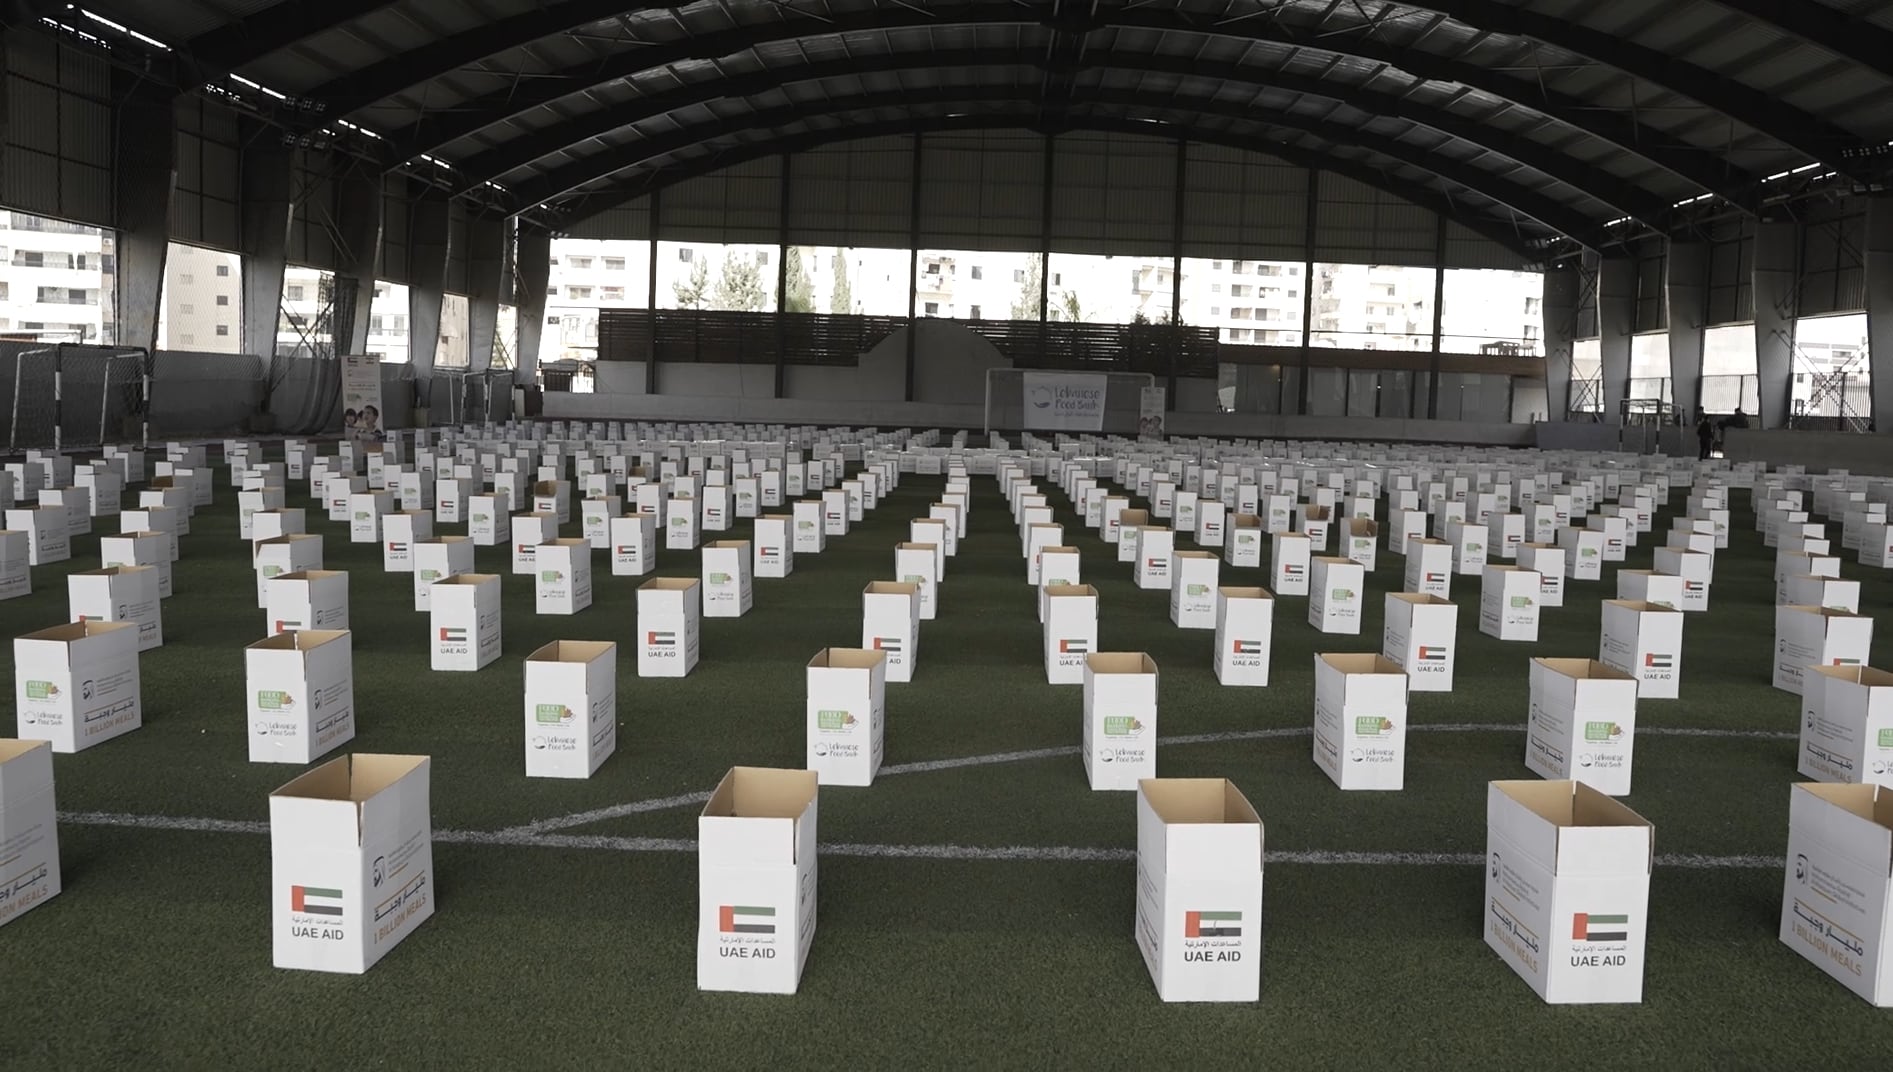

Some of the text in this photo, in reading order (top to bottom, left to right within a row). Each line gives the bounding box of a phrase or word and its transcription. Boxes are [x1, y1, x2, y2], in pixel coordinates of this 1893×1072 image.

[1055, 385, 1101, 400] Lebanese
[1055, 398, 1099, 410] Food Bank
[89, 720, 114, 735] BILLION
[115, 712, 135, 728] MEALS
[18, 884, 48, 908] MEALS
[378, 915, 406, 942] BILLION
[406, 894, 426, 919] MEALS
[292, 926, 344, 940] UAE AID
[1793, 902, 1864, 956] مليار وجبة
[720, 947, 776, 959] UAE AID
[1184, 951, 1241, 962] UAE AID
[1494, 923, 1516, 952] BILLION
[1516, 944, 1538, 973] MEALS
[1796, 924, 1829, 956] BILLION
[1830, 948, 1863, 977] MEALS
[1570, 955, 1626, 967] UAE AID
